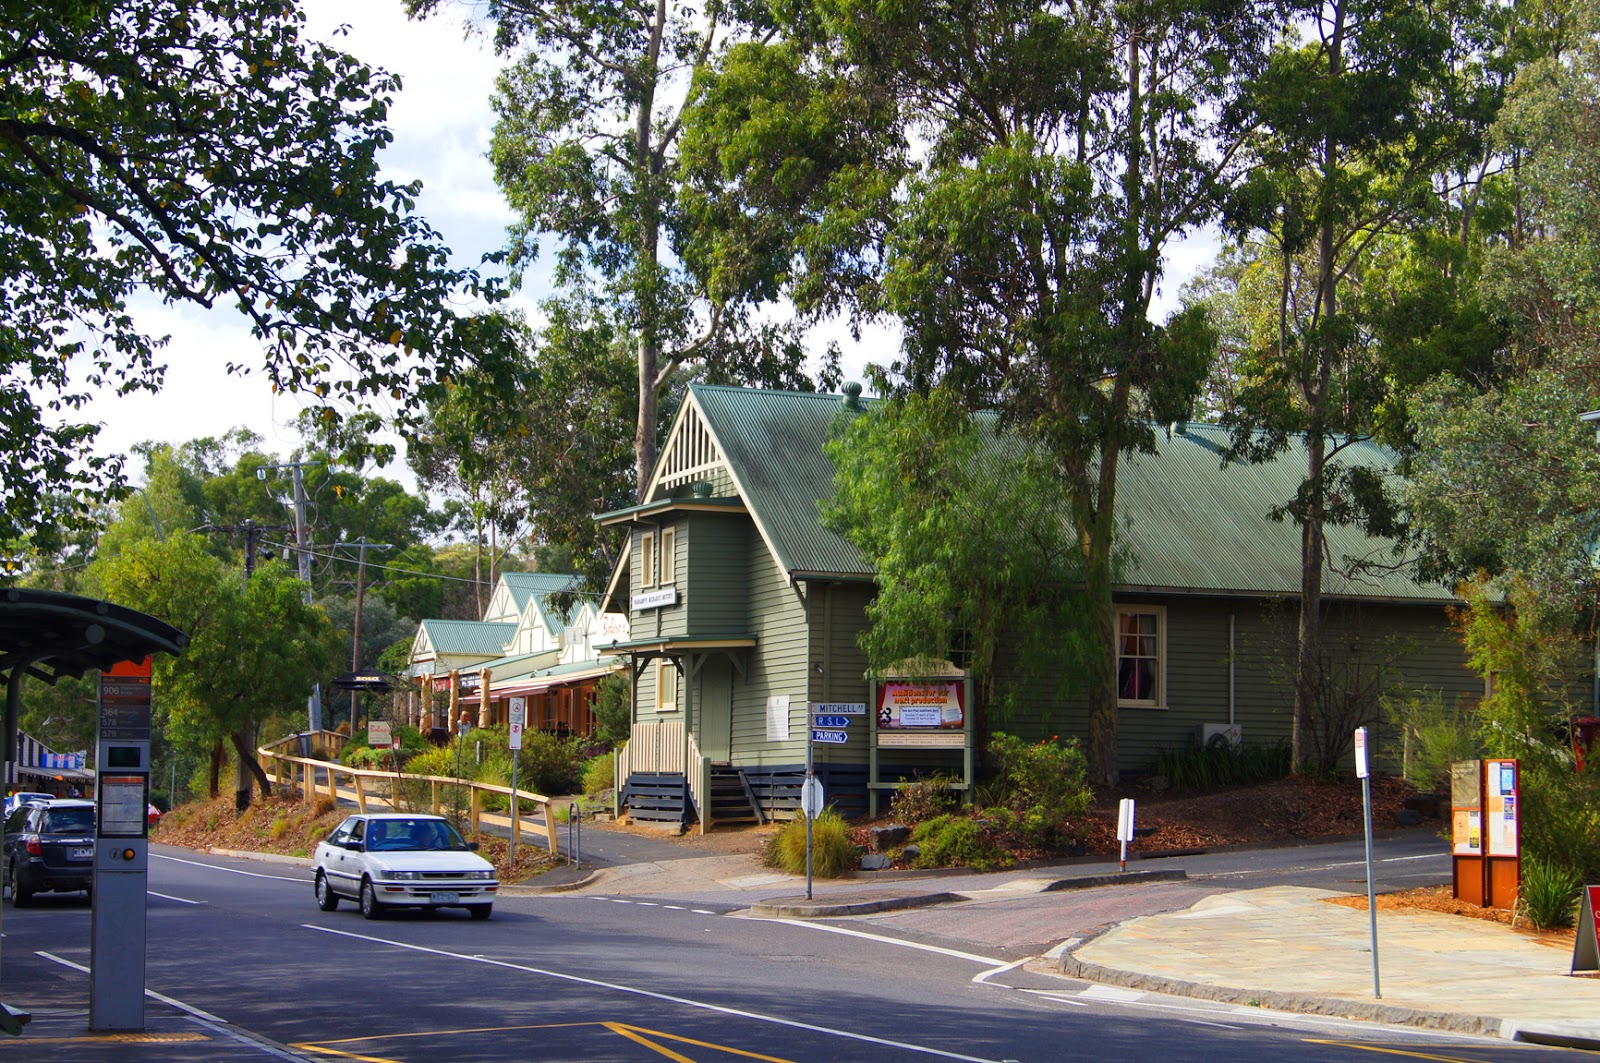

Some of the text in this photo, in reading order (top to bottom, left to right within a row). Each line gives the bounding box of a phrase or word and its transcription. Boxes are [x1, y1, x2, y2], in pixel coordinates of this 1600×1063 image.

[103, 686, 119, 695] 906
[911, 696, 947, 705] production
[102, 708, 118, 716] 364
[819, 704, 857, 713] MITCHELL
[816, 731, 843, 741] PARKING
